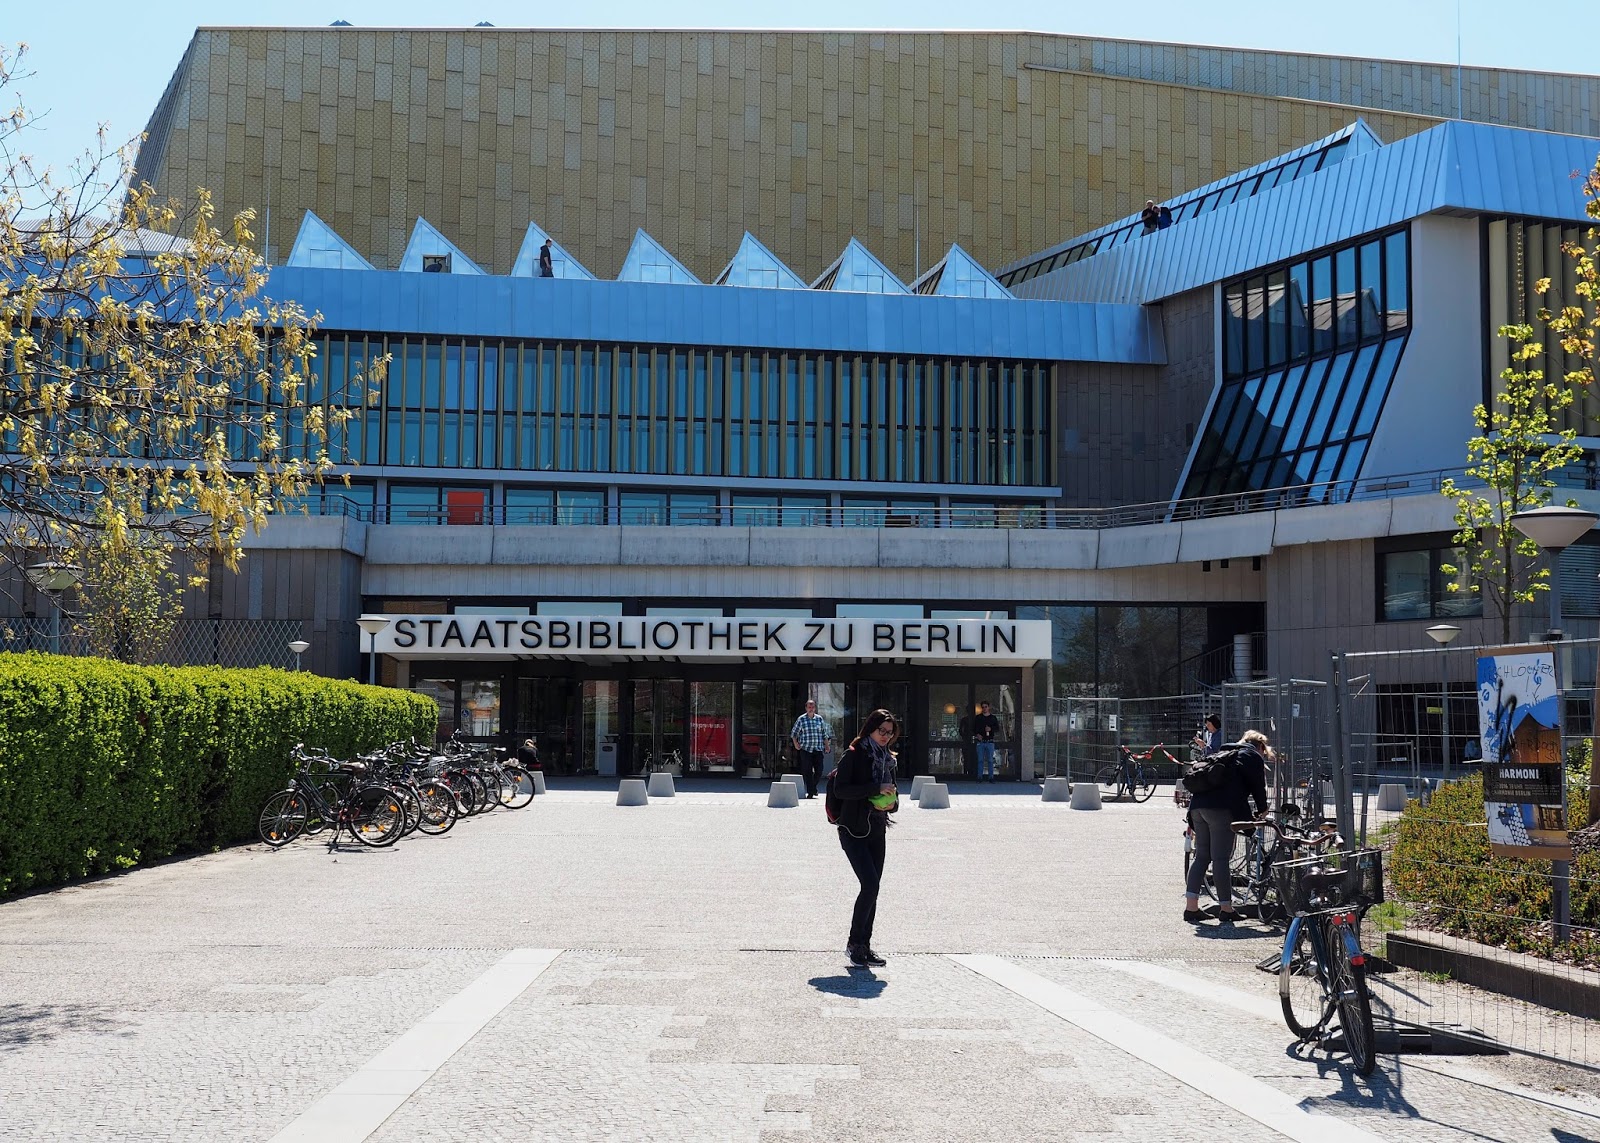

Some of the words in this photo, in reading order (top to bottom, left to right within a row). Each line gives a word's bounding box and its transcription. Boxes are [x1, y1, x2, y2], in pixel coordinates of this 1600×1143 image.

[393, 619, 787, 651] STAATSBIBLIOTHEK
[803, 623, 853, 652] ZU
[873, 623, 1016, 653] BERLIN
